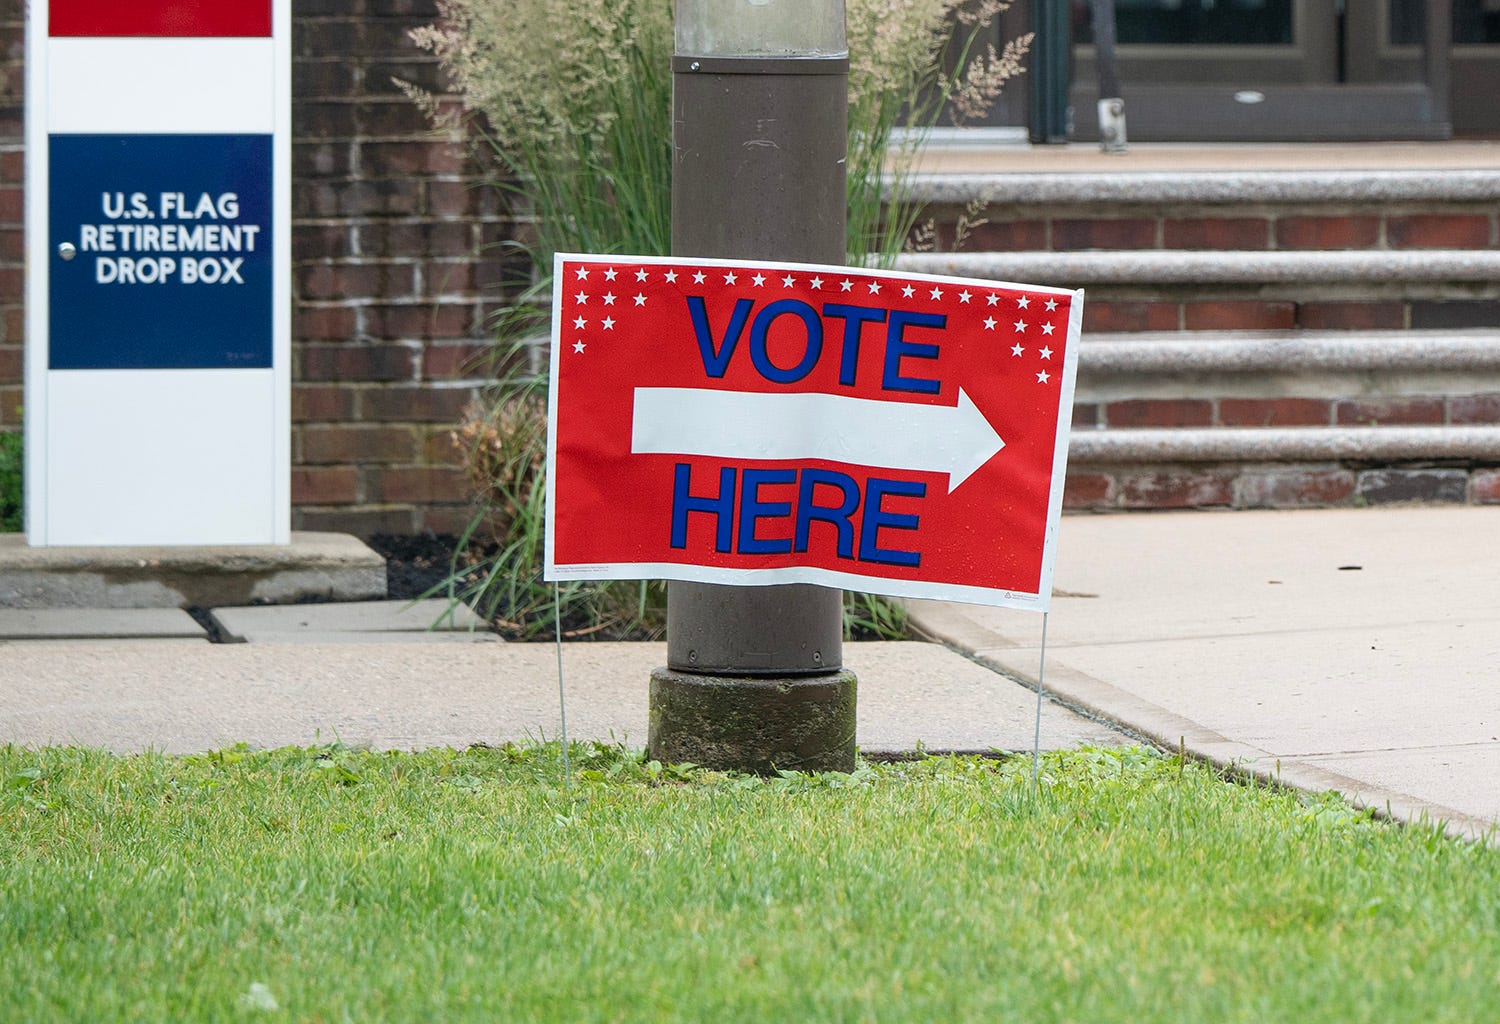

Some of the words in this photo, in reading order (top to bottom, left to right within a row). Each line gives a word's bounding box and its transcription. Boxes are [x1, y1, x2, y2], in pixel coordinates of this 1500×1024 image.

[102, 192, 155, 219] U.S.
[160, 192, 240, 219] FLAG
[80, 225, 260, 252] RETIREMENT
[95, 257, 176, 284] DROP
[180, 257, 245, 284] BOX
[686, 296, 948, 395] VOTE
[670, 463, 927, 568] HERE
